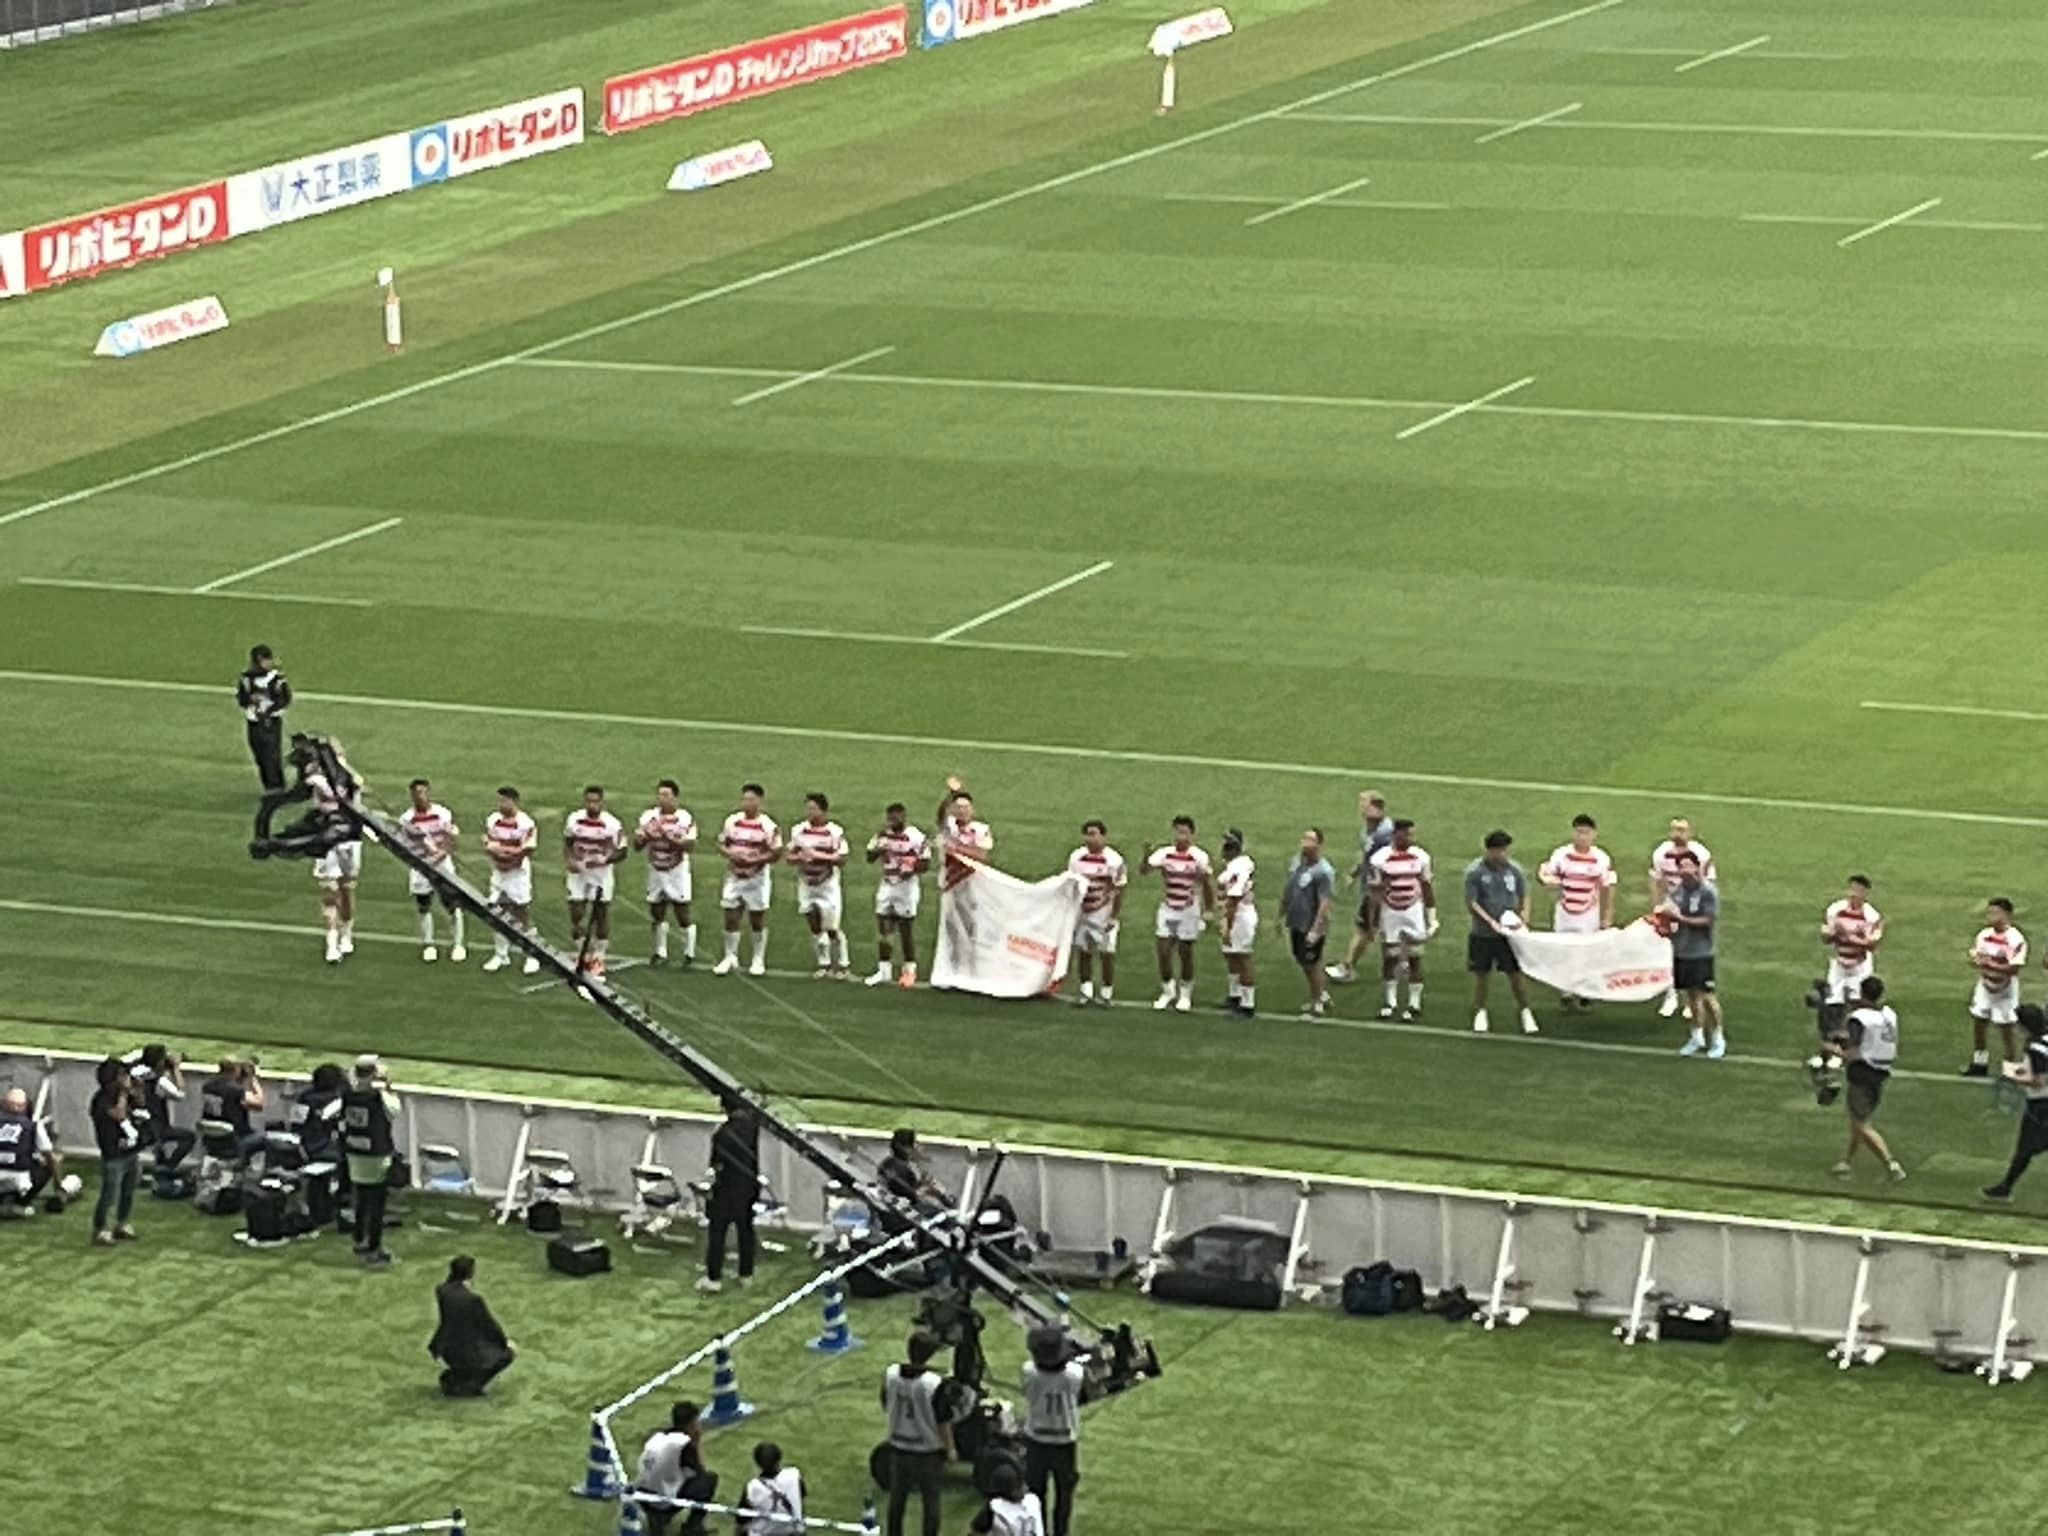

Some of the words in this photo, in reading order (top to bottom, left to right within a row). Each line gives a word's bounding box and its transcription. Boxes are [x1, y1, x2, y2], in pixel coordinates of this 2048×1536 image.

[453, 103, 577, 163] リポビタンD
[39, 195, 217, 278] リポビタンD
